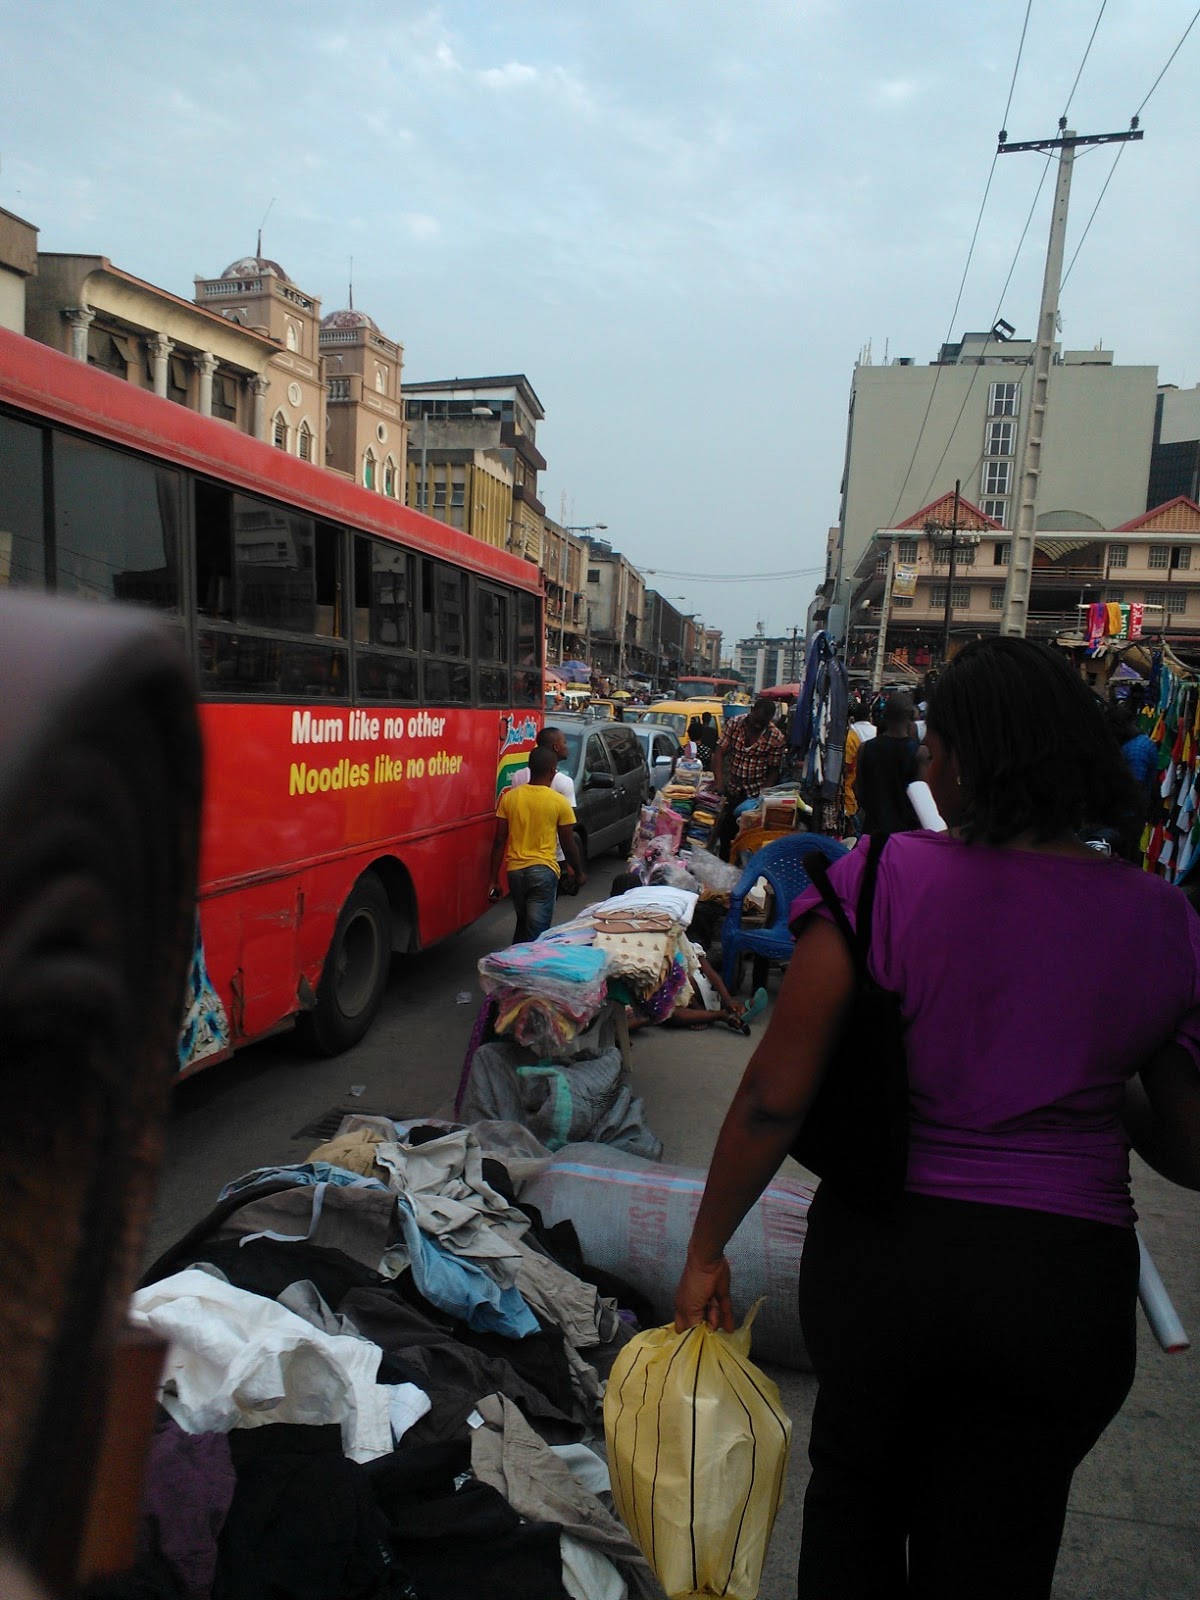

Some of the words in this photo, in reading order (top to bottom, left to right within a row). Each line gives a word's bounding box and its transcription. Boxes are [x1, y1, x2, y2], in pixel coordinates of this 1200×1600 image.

[291, 710, 343, 744] Mum
[348, 709, 380, 741] like
[384, 716, 404, 740] no
[407, 711, 446, 738] other
[289, 758, 370, 796] Noodles
[374, 753, 402, 784] like
[406, 759, 426, 779] no
[428, 751, 463, 776] other
